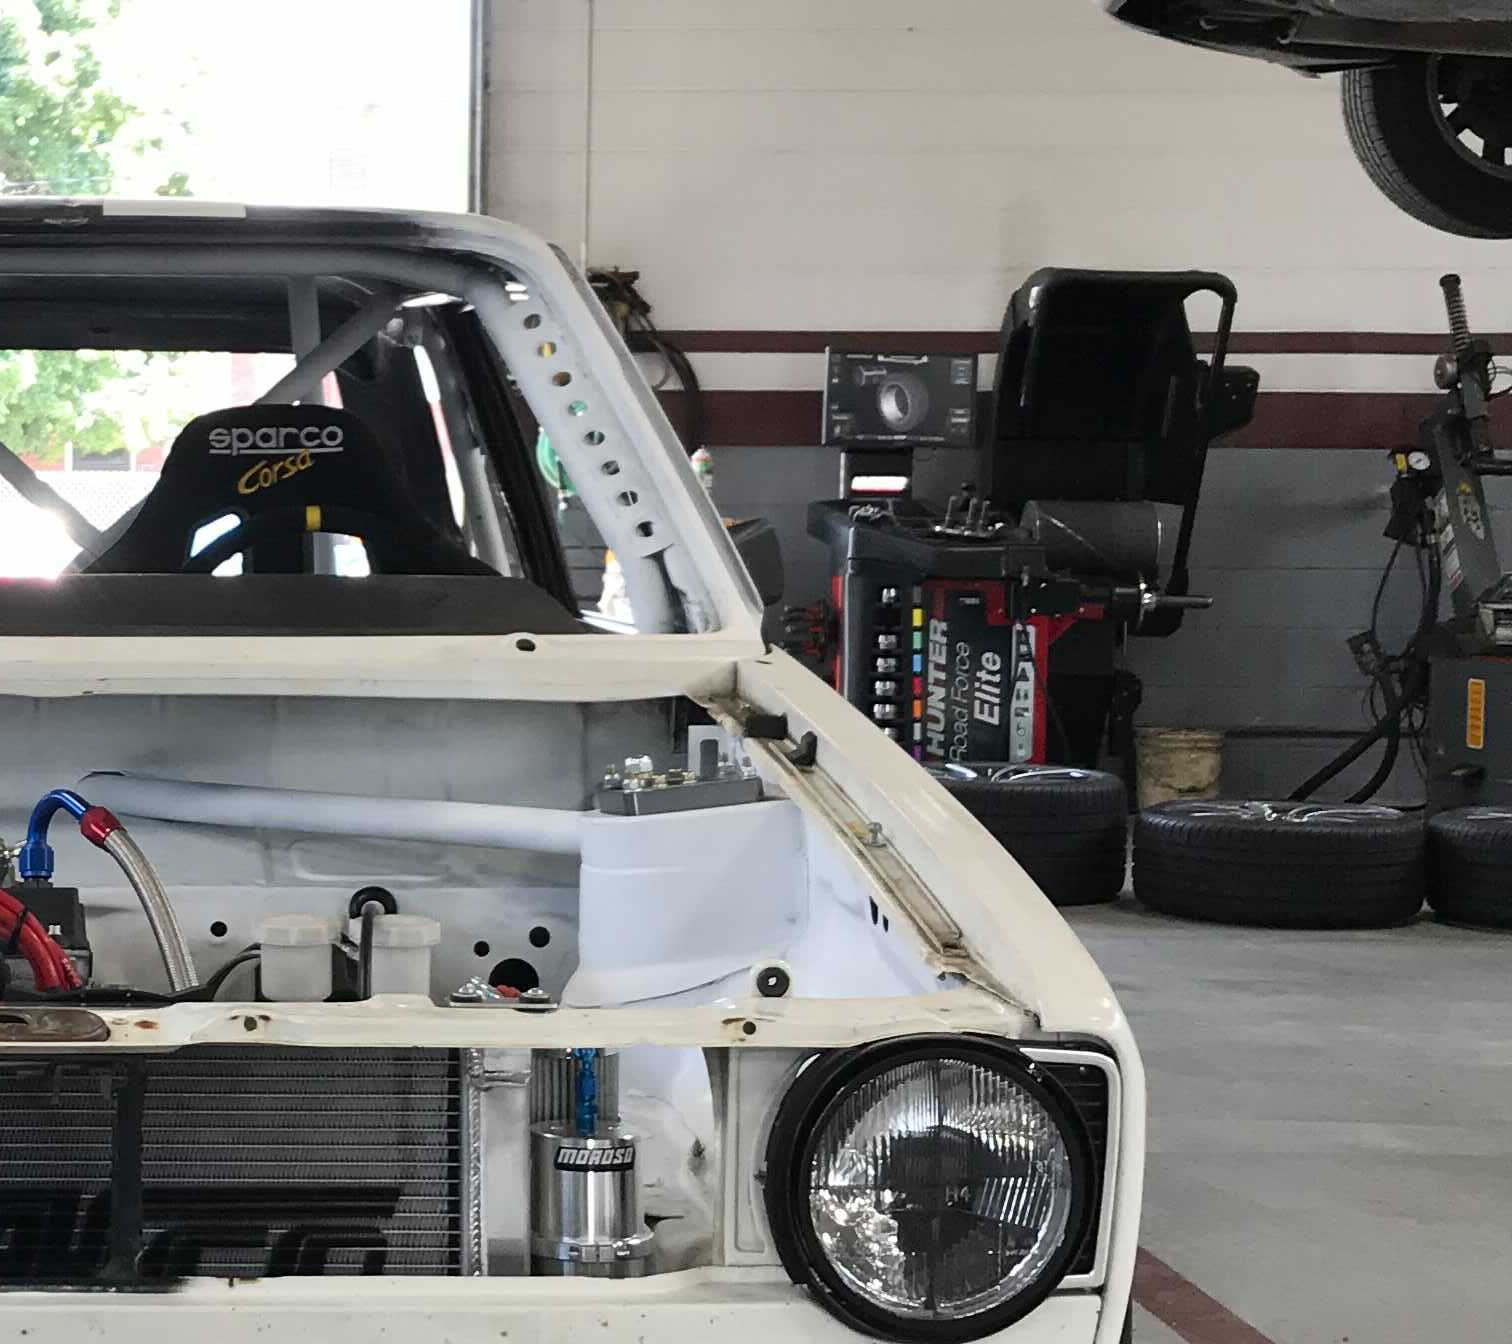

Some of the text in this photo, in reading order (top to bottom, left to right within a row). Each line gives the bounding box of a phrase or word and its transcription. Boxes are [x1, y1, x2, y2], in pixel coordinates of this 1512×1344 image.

[209, 425, 343, 456] sparco
[237, 448, 314, 494] Corsa
[926, 618, 948, 757] HUNTER
[949, 641, 970, 761] Road Force
[973, 651, 1001, 726] Elite
[557, 1147, 634, 1165] MOROSO
[945, 1185, 970, 1202] H4
